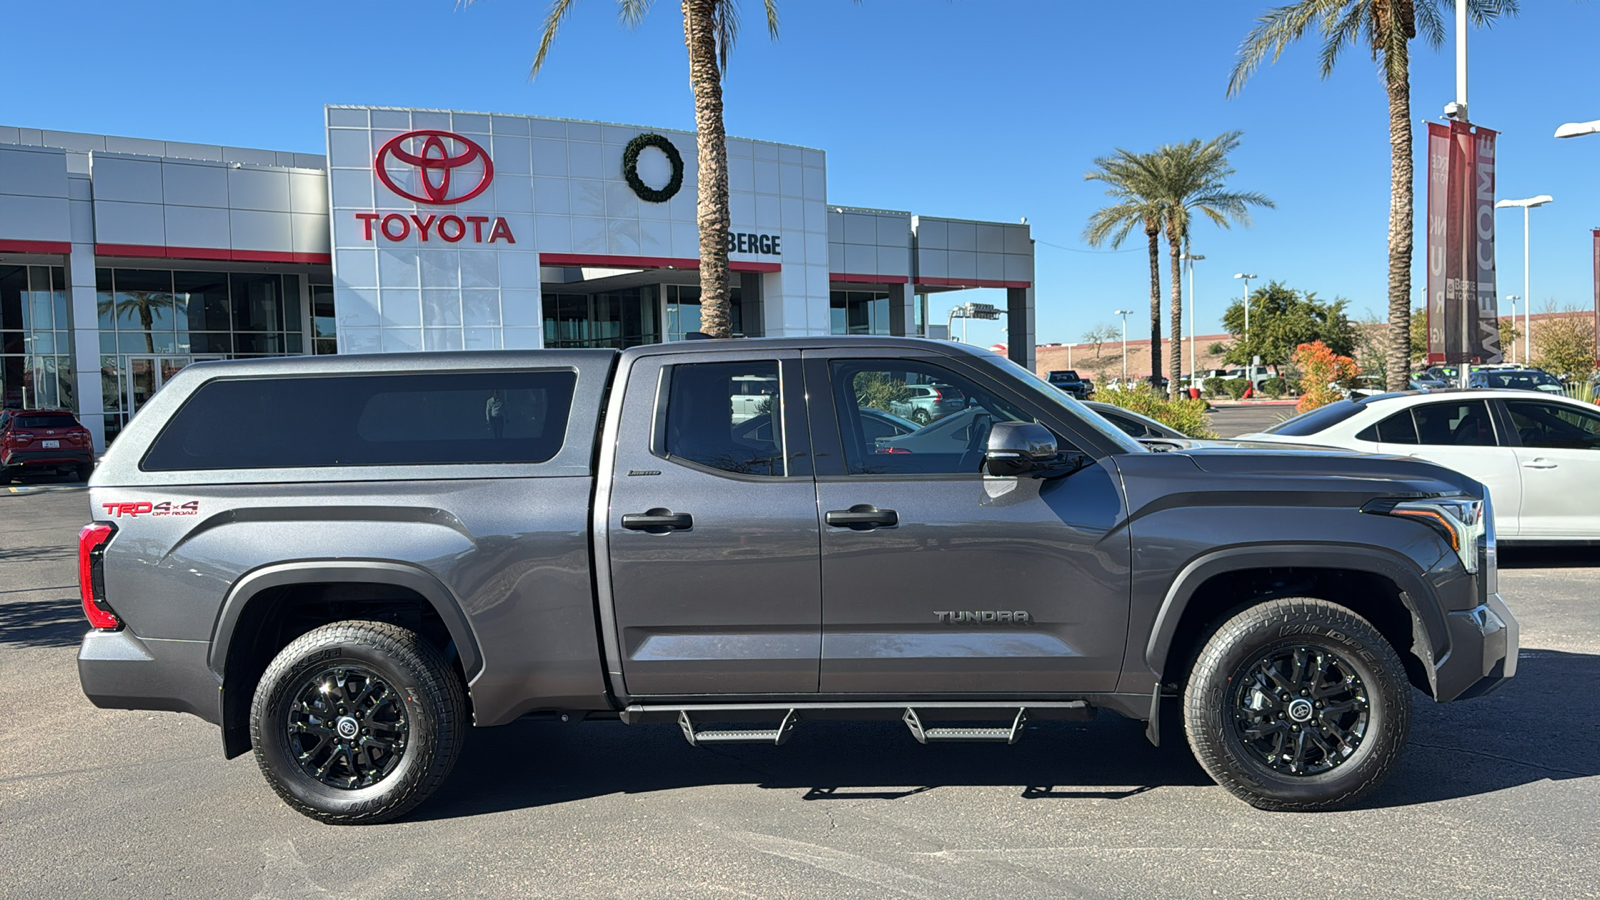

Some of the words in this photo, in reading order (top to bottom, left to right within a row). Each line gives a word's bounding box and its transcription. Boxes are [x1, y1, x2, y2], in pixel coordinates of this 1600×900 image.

[355, 213, 516, 244] TOYOTA
[728, 232, 781, 255] BERGE
[102, 501, 153, 517] TRD
[933, 610, 1030, 622] TUNDRA
